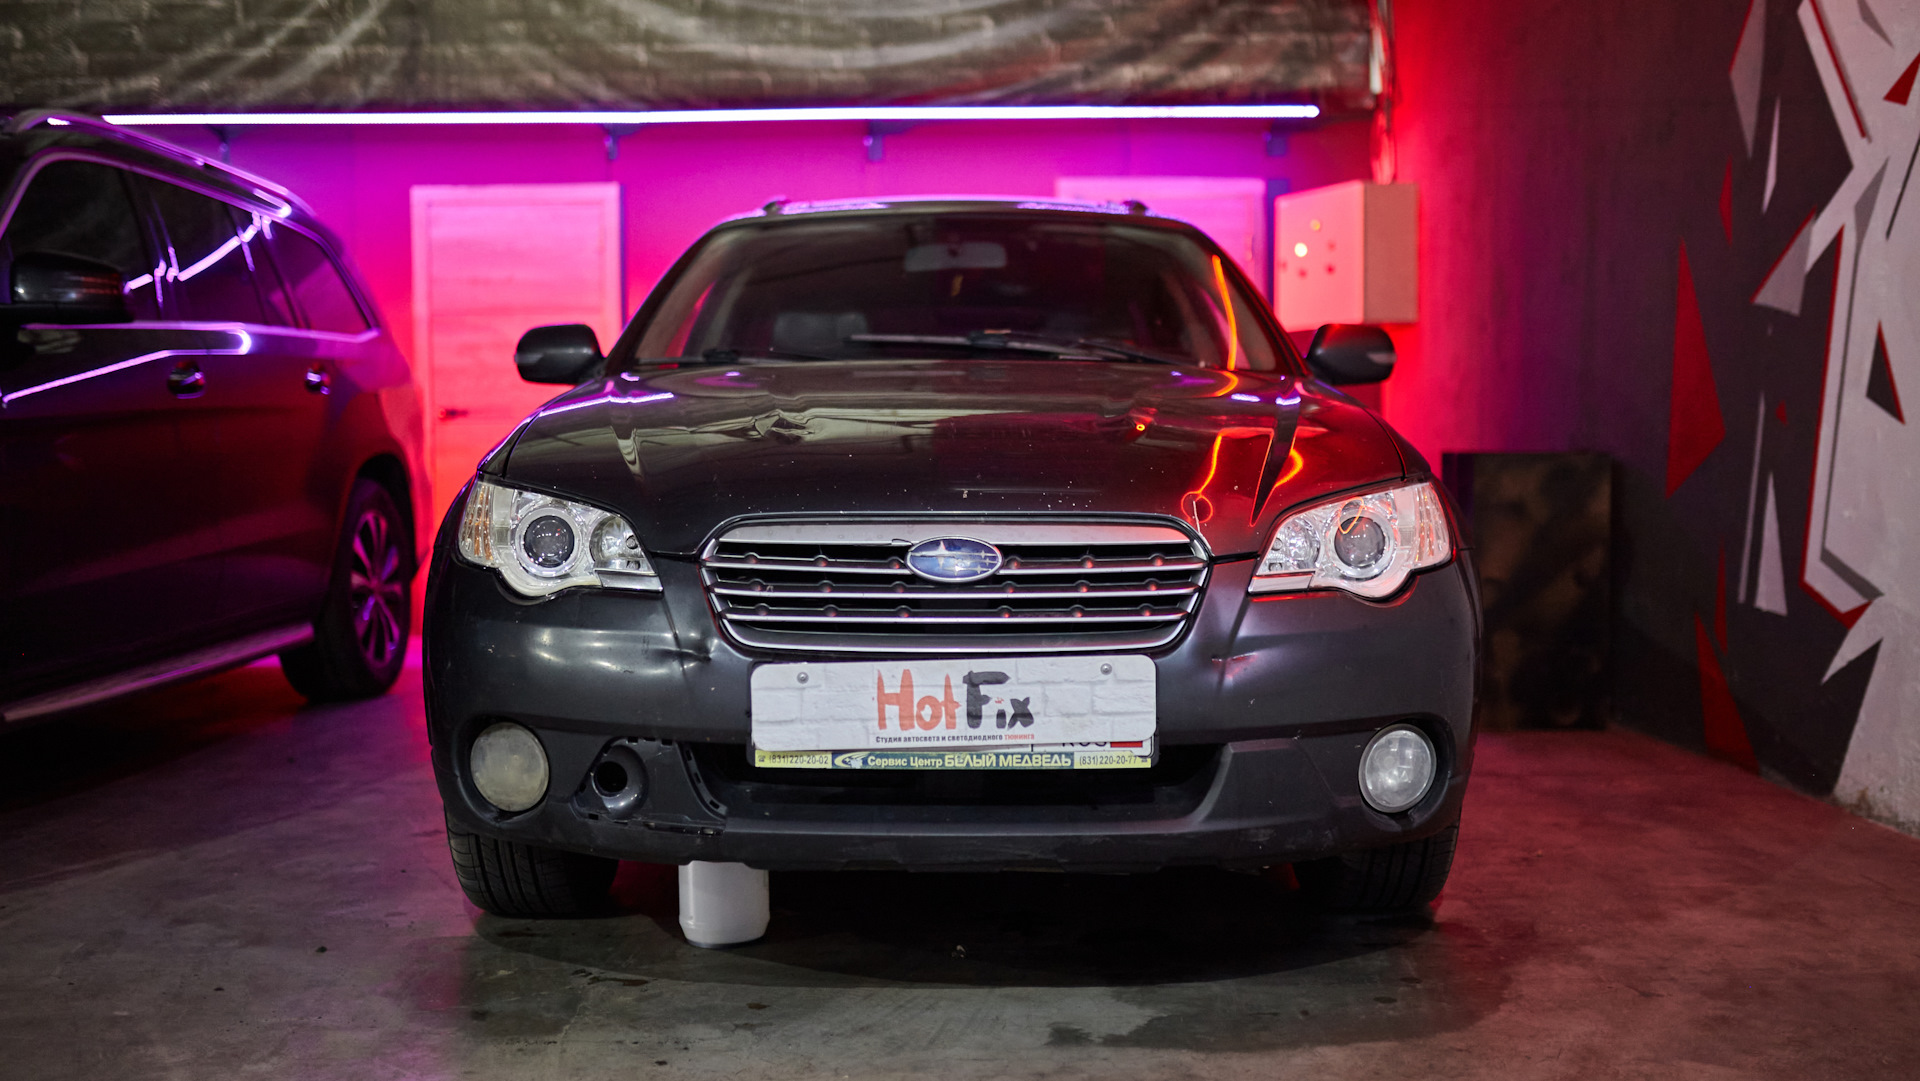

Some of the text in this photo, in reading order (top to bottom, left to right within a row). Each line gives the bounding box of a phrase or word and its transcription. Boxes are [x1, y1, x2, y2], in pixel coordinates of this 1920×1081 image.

[876, 736, 902, 744] Студия
[903, 735, 941, 743] автосвета
[947, 734, 1003, 743] светодиодного
[1004, 733, 1035, 741] тюнинга
[867, 753, 1072, 768] Сервис Центр БЕЛЫЙ МЕДВЕДЬ
